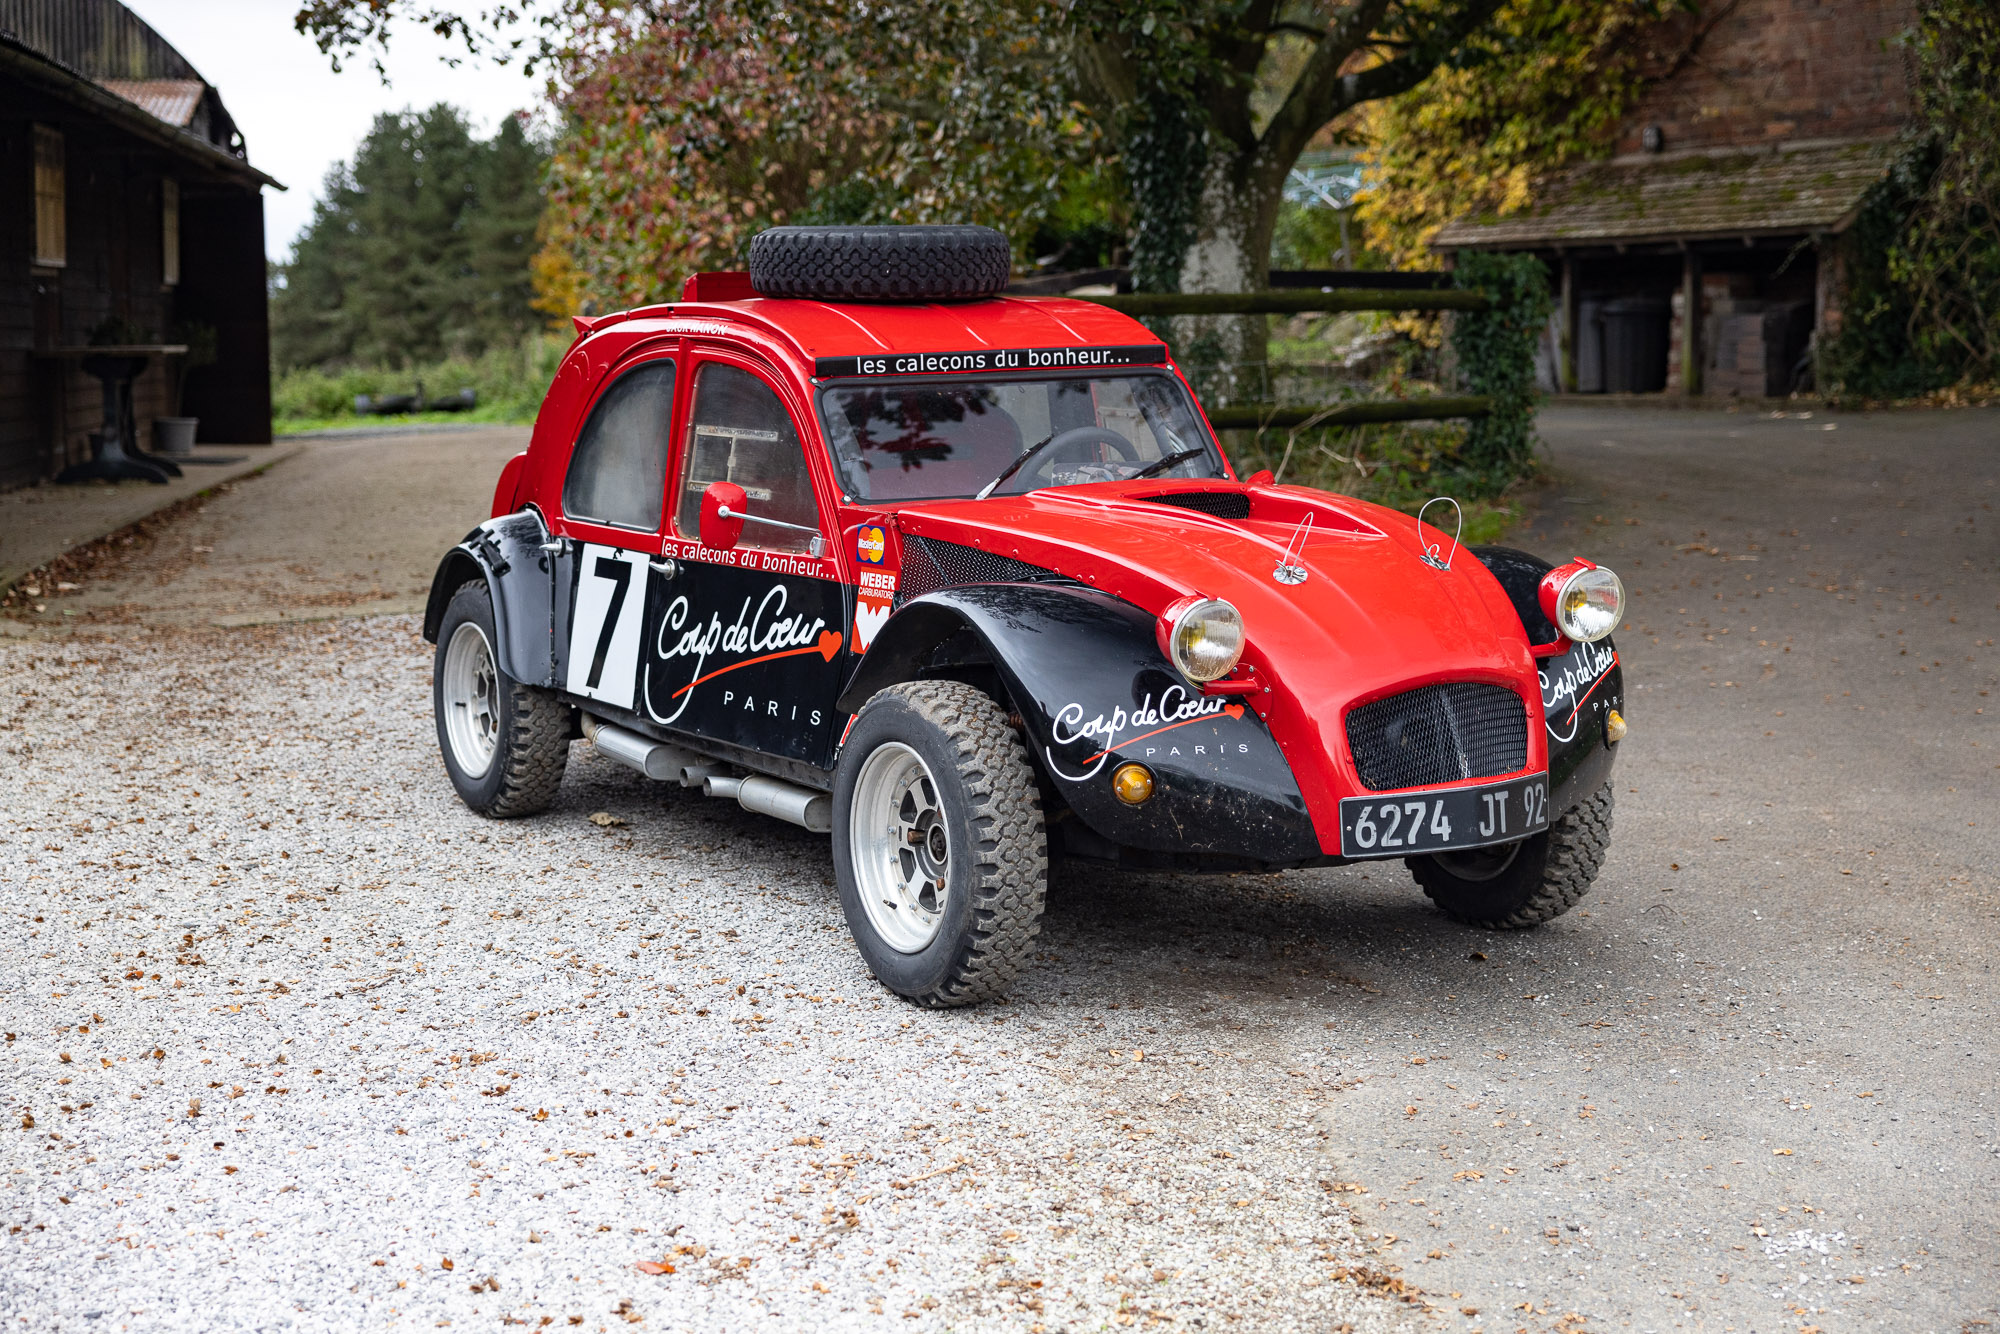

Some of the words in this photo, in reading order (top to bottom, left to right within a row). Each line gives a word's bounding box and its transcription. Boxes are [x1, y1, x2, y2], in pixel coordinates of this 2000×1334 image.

[856, 356, 886, 374] les
[895, 353, 986, 372] caleçons
[995, 350, 1019, 367] du
[1028, 347, 1131, 366] bonheur...
[661, 538, 678, 556] les
[682, 541, 737, 565] caleçons
[741, 550, 758, 568] du
[763, 551, 836, 579] bonheur...
[858, 538, 884, 552] MasterCard
[858, 586, 895, 600] CARBURATORS
[860, 571, 896, 590] WEBER
[586, 556, 632, 690] 7
[644, 595, 722, 725] Coup
[722, 596, 752, 654] de
[723, 691, 822, 726] PARIS
[1592, 696, 1623, 712] PAR
[1046, 702, 1127, 782] Coup
[1131, 693, 1160, 727] de
[1146, 744, 1249, 757] PARIS
[1355, 800, 1452, 849] 6274
[1479, 791, 1509, 837] JT
[1524, 783, 1546, 828] 92
